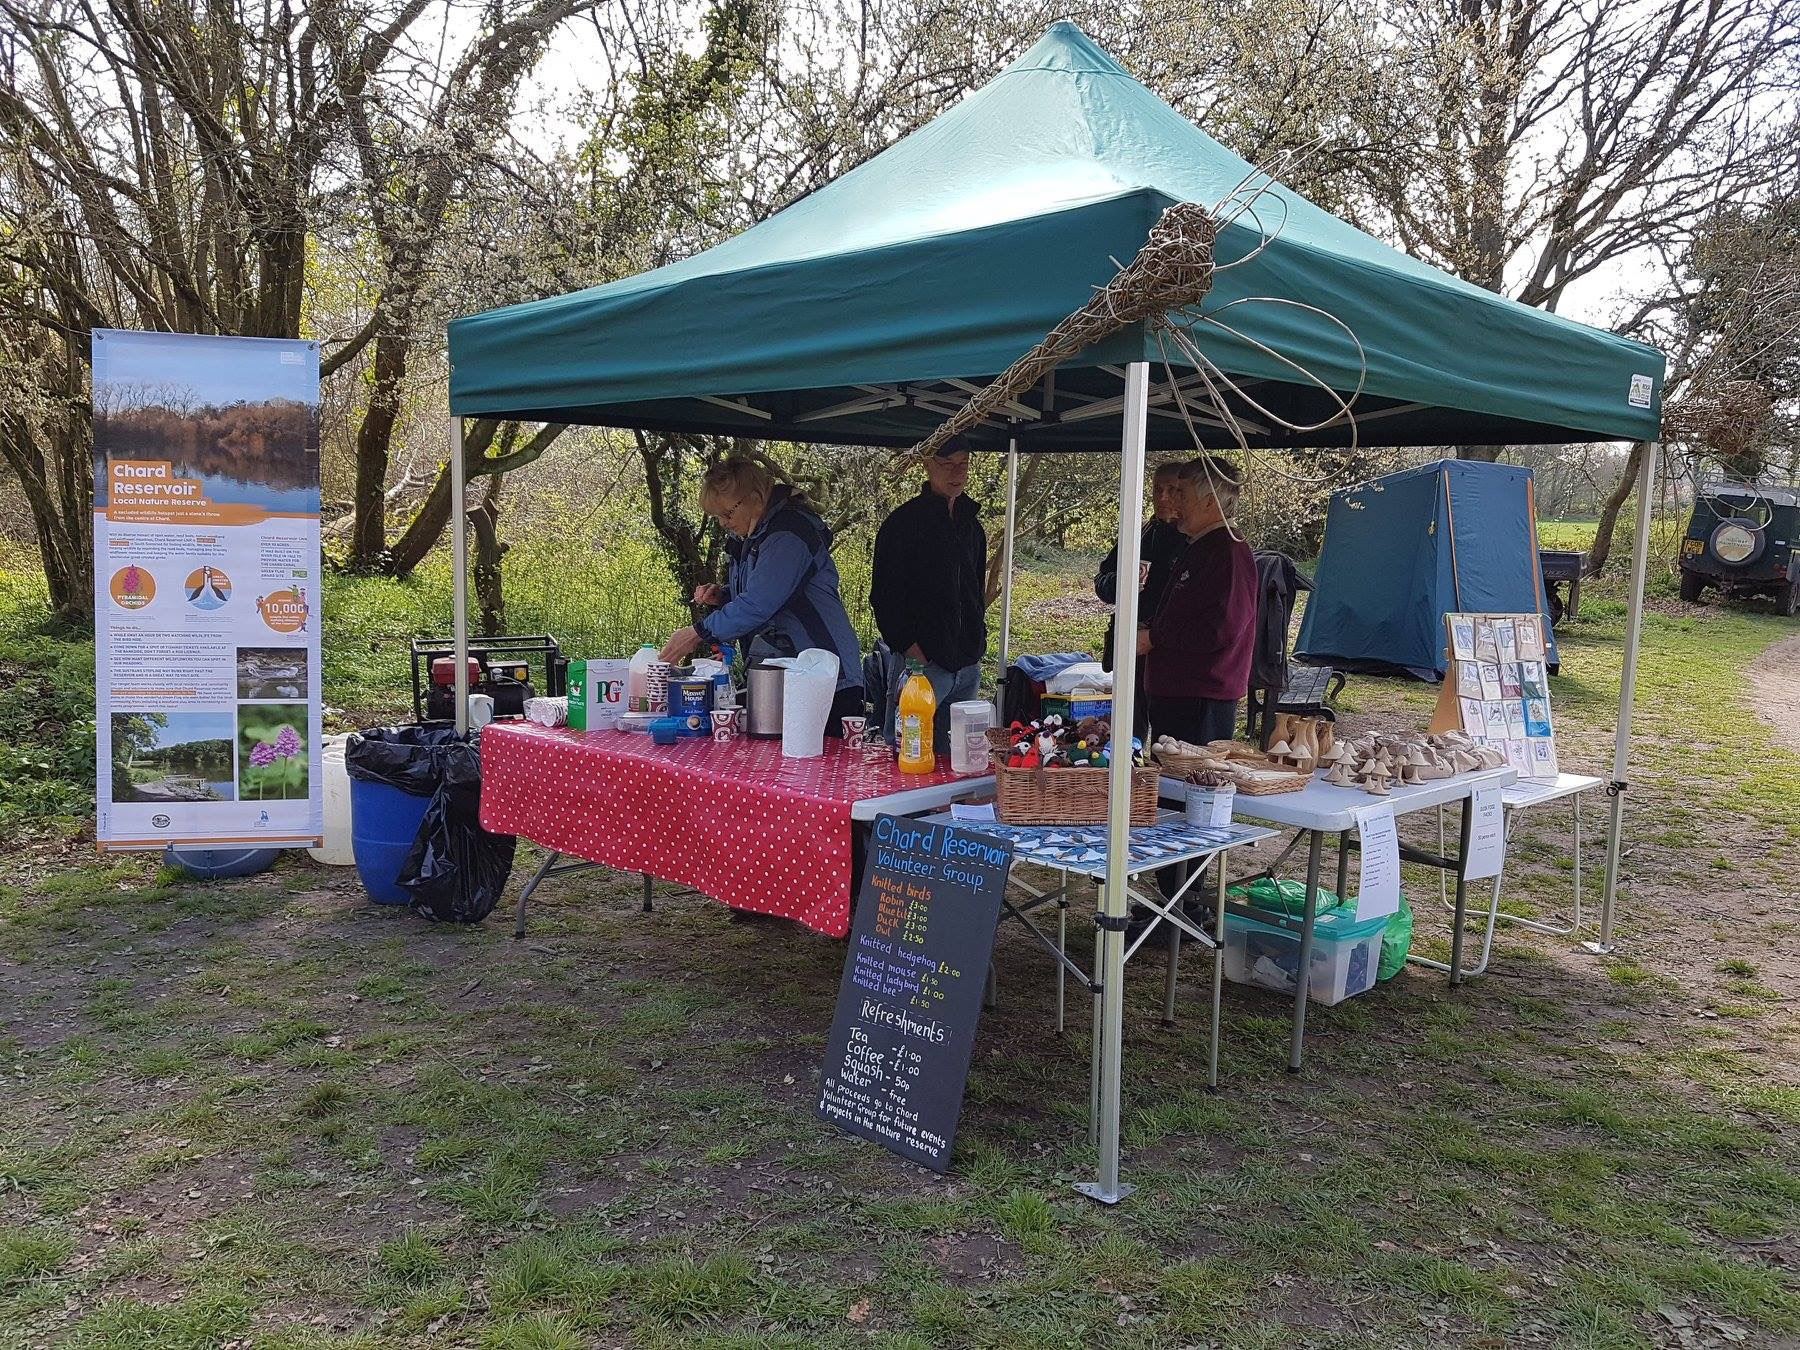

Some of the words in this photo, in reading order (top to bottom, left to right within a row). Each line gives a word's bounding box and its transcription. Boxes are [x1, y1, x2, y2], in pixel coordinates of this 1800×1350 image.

[114, 464, 166, 477] Chard
[113, 497, 136, 505] Local
[114, 482, 197, 495] Reservoir
[265, 603, 304, 614] 10,000
[596, 680, 621, 703] PG
[876, 816, 935, 850] Chard
[940, 827, 1010, 866] Reservoir
[877, 850, 936, 877] Volunteer
[943, 863, 984, 895] Group
[871, 874, 904, 894] Knitted
[906, 883, 932, 901] birds
[880, 892, 904, 907] Robin
[875, 924, 891, 937] Owl
[877, 914, 899, 928] Duck
[856, 952, 885, 971] Knitted
[888, 963, 917, 979] mouse
[860, 934, 892, 954] Knitted
[898, 946, 937, 973] hedgehog
[852, 974, 880, 994] Knitted
[882, 981, 897, 997] bee
[854, 965, 883, 983] Knitted
[886, 970, 920, 994] ladybird
[861, 1000, 944, 1042] Refreshments
[850, 1027, 868, 1044] Tea
[847, 1041, 885, 1065] Coffee
[844, 1054, 883, 1081] Squash
[895, 1076, 910, 1092] 50p
[825, 1078, 835, 1088] All
[838, 1084, 870, 1103] proceeds
[874, 1099, 882, 1109] go
[886, 1101, 893, 1111] to
[896, 1106, 918, 1121] Chard
[841, 1068, 872, 1088] Water
[889, 1090, 907, 1106] free
[823, 1089, 856, 1108] Volunteer
[858, 1102, 876, 1119] Group
[879, 1112, 891, 1123] for
[894, 1118, 917, 1135] future
[921, 1129, 946, 1148] events
[827, 1102, 852, 1119] projects
[854, 1115, 861, 1124] in
[863, 1116, 873, 1130] the
[876, 1123, 900, 1141] nature
[906, 1136, 938, 1158] reserve
